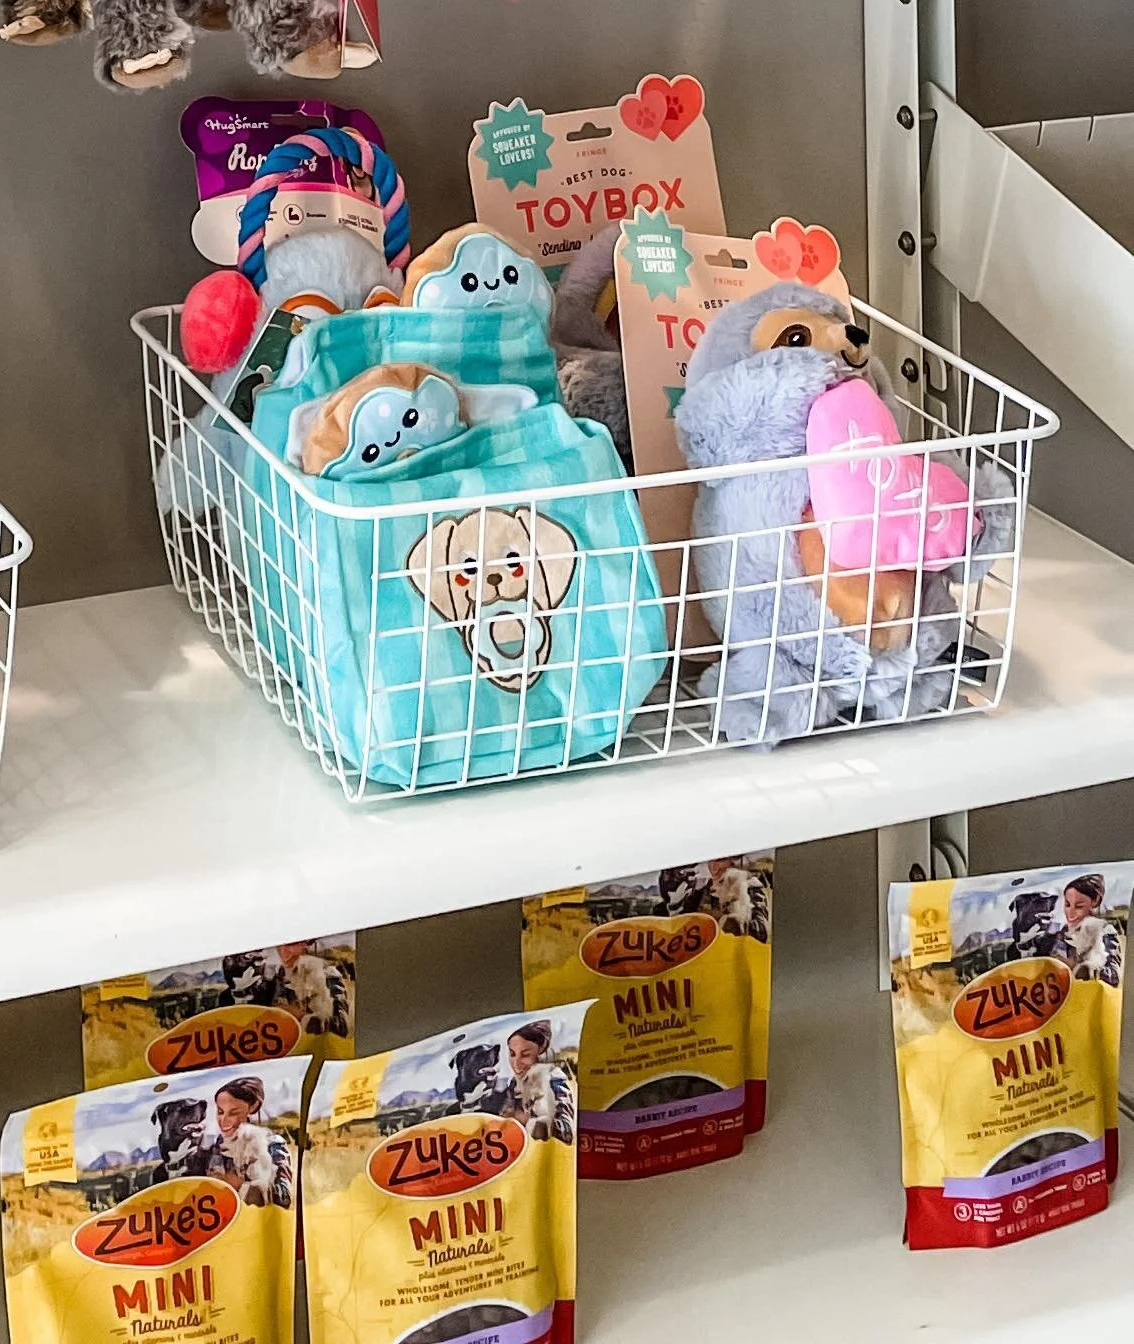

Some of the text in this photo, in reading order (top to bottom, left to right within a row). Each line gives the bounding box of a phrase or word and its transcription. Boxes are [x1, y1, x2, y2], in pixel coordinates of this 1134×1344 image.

[204, 113, 270, 135] HugSmart
[492, 135, 537, 154] SQUEAKER
[575, 147, 608, 158] FRINGE
[498, 148, 536, 167] LOVERS!
[566, 167, 628, 186] BEST DOG
[516, 177, 686, 233] TOYBOX
[636, 246, 677, 261] SQUEAKER
[642, 259, 676, 273] LOVERS!
[712, 278, 744, 288] FRINGE
[613, 978, 693, 1024] MINI
[628, 1014, 686, 1039] Naturals
[992, 1033, 1066, 1088] MINI
[1006, 1071, 1060, 1101] Naturals
[39, 1149, 60, 1160] USA
[408, 1197, 504, 1251] MINI
[427, 1238, 492, 1268] Naturals
[506, 1261, 525, 1272] BITES
[112, 1264, 216, 1320] MINI
[379, 1298, 397, 1307] FOR
[399, 1296, 414, 1305] ALL
[417, 1293, 440, 1304] YOUR
[443, 1282, 492, 1300] ADVENTURES
[131, 1309, 203, 1338] Naturals
